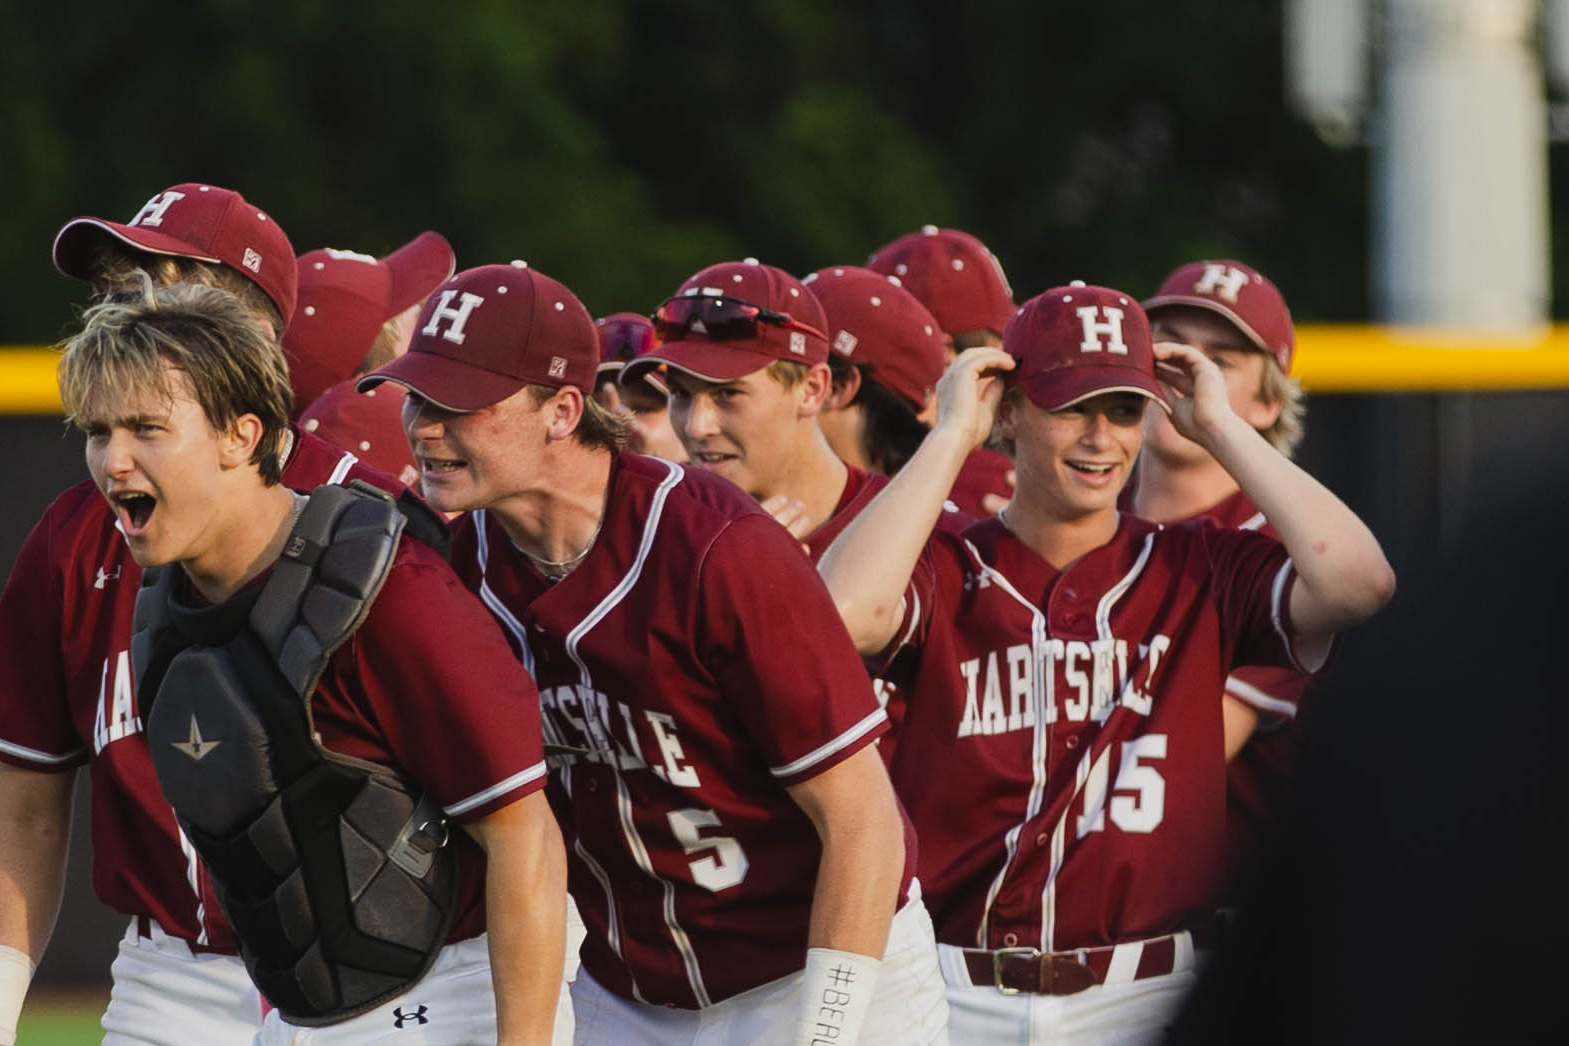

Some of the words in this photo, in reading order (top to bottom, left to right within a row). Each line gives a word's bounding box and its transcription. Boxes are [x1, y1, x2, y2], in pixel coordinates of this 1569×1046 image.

[125, 190, 186, 228] H
[1193, 263, 1250, 305] H
[421, 289, 486, 346] H
[1076, 305, 1129, 356] H
[1076, 734, 1168, 840] 15
[666, 808, 751, 893] 5
